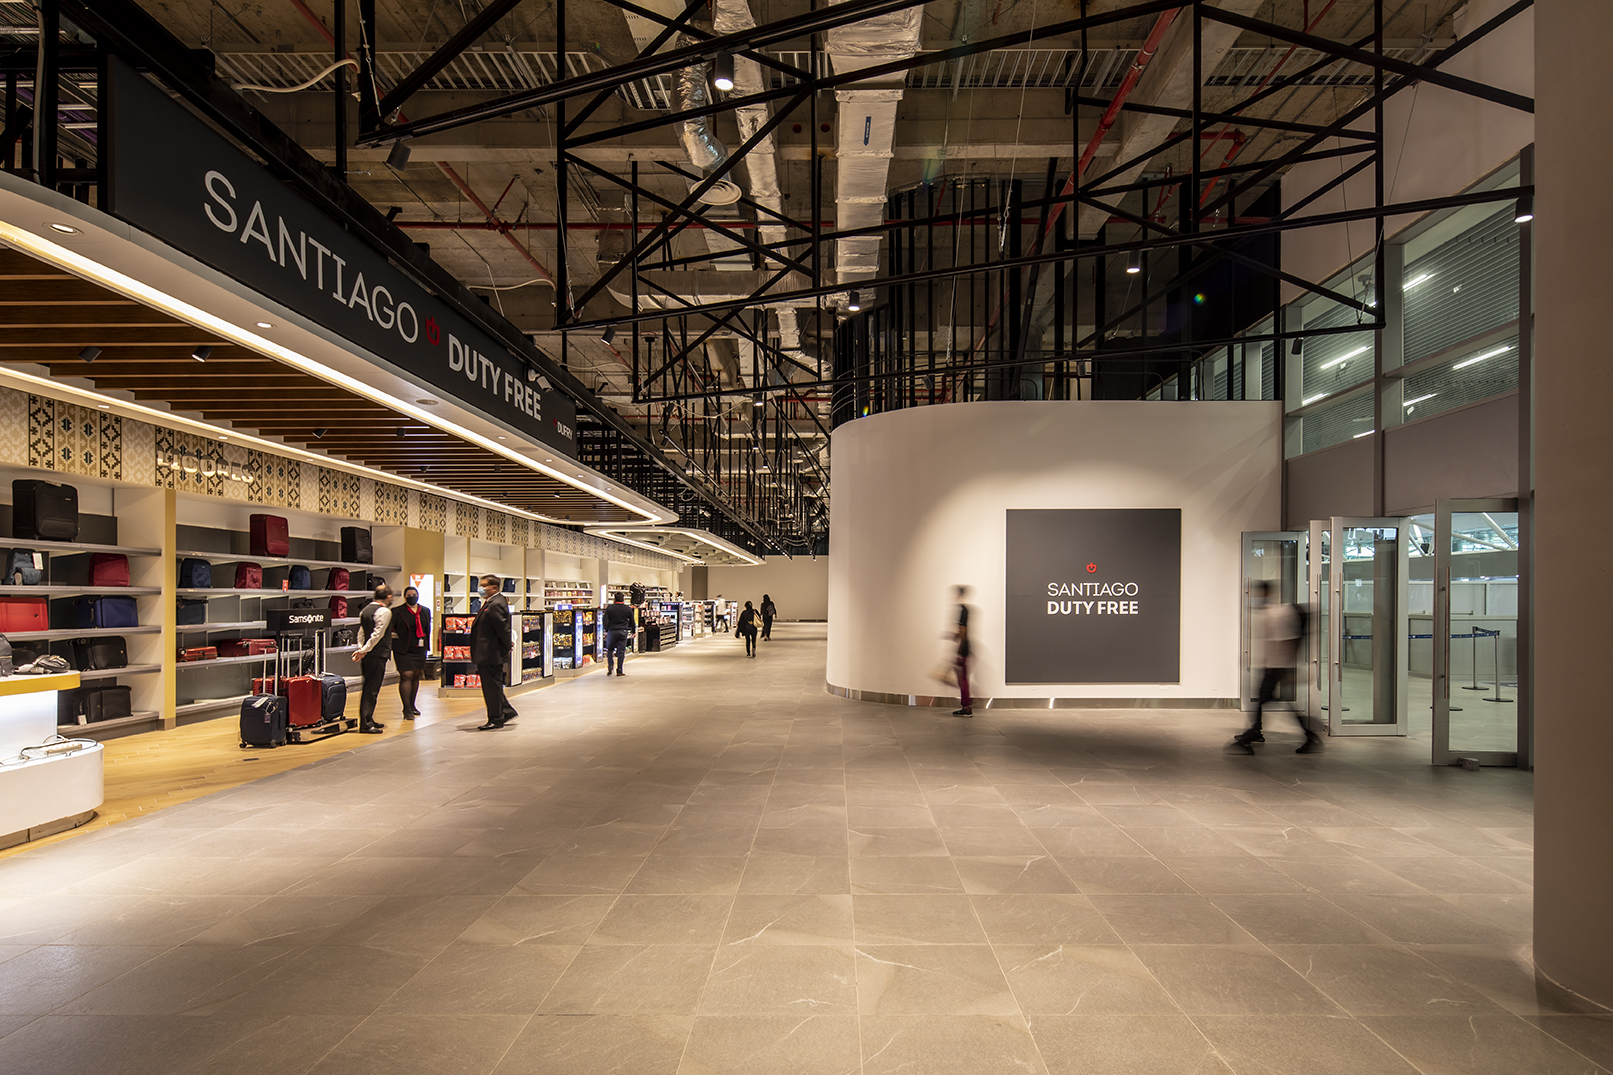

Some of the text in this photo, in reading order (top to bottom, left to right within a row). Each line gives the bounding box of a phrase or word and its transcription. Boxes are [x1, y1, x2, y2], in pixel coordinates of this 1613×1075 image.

[203, 170, 542, 421] SANTIAGO DUTY FREE
[157, 445, 254, 483] LICORES
[1047, 582, 1139, 597] SANTIAGO
[1047, 601, 1139, 615] DUTY FREE
[288, 614, 324, 624] Samsonite
